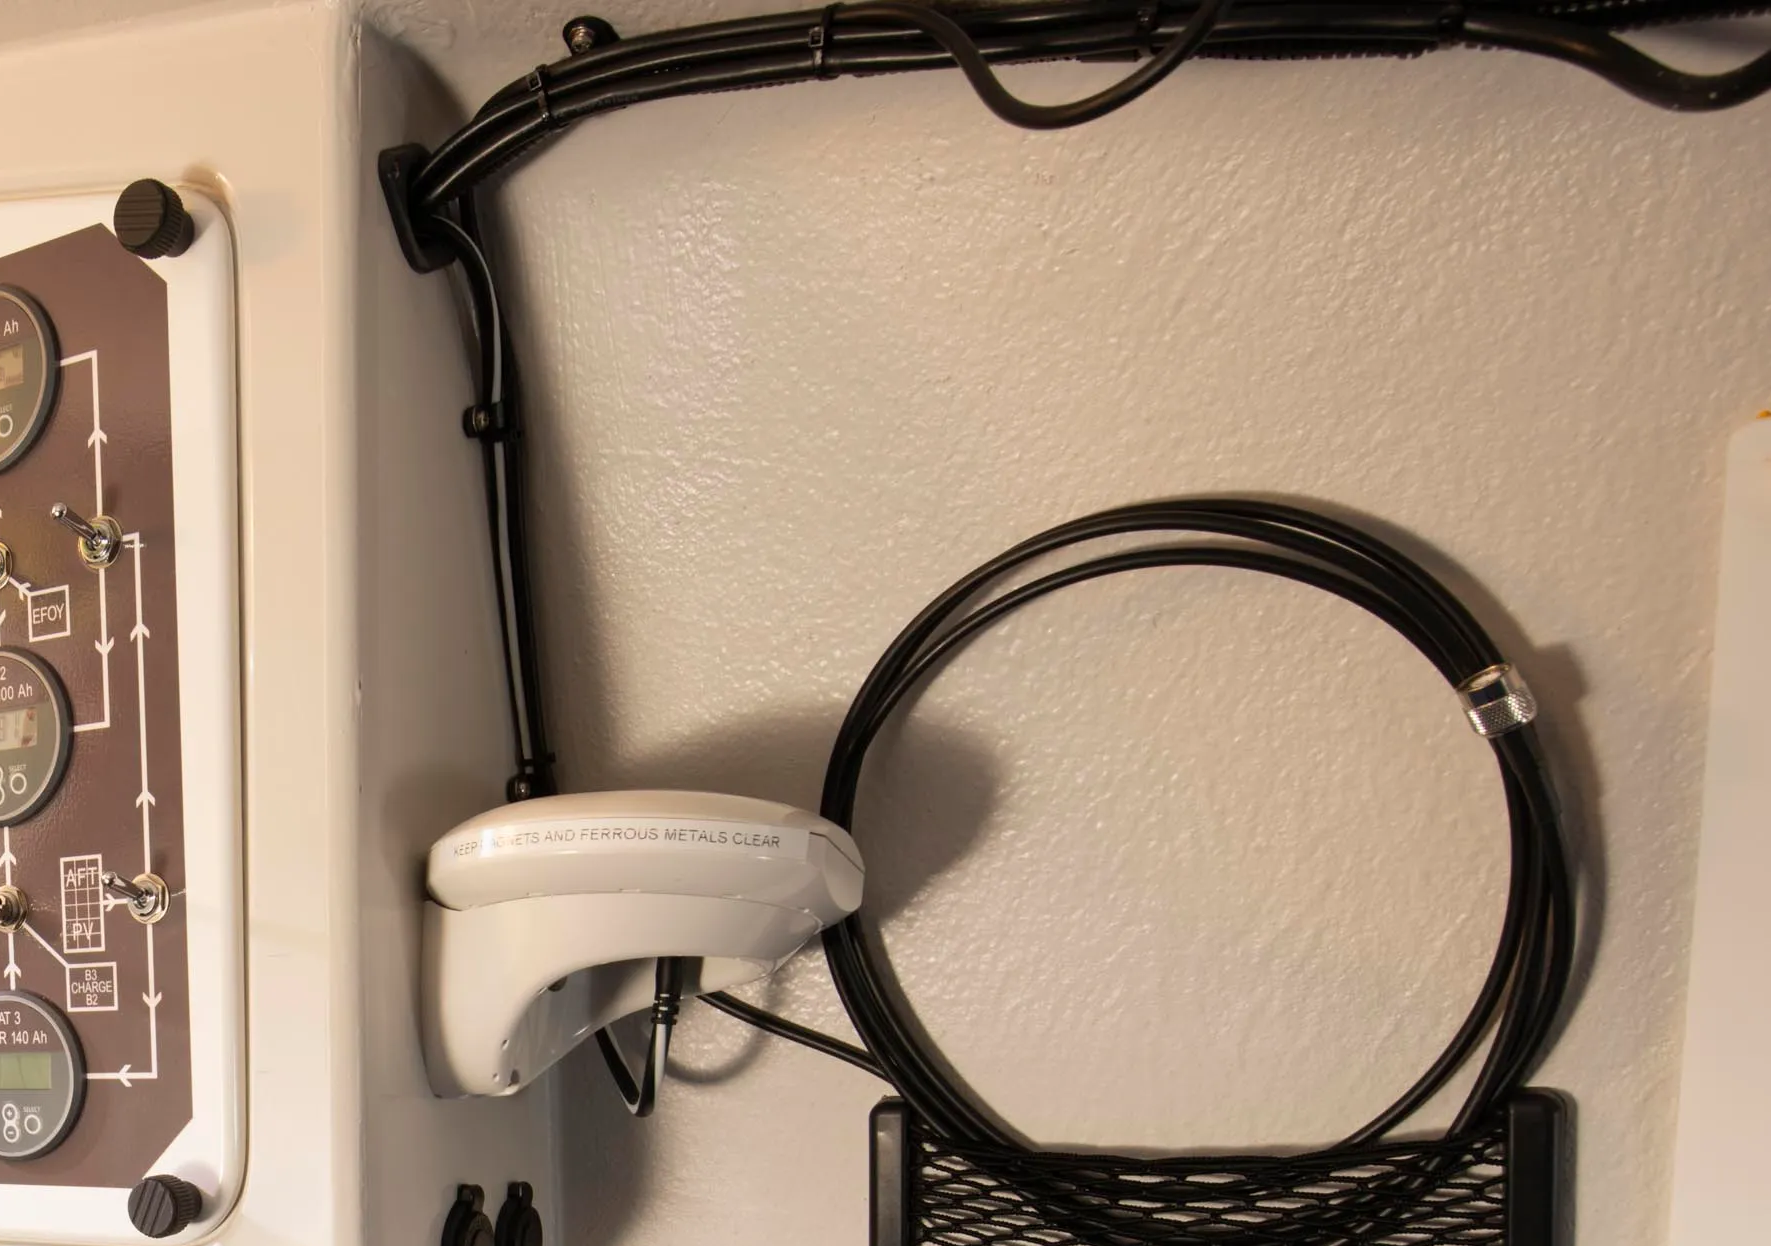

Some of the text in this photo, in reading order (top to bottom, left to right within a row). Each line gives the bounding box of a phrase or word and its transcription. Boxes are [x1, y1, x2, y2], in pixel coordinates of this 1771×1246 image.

[3, 319, 19, 337] Ah
[31, 602, 64, 625] EFOY
[0, 666, 7, 680] 2
[18, 683, 33, 699] Ah
[453, 841, 478, 857] KEEP
[544, 829, 576, 842] AND
[580, 827, 659, 841] FERROUS
[664, 828, 728, 844] METALS
[732, 832, 781, 848] CLEAR
[66, 867, 97, 888] AFT
[72, 921, 94, 941] PV
[84, 969, 97, 981] B3
[71, 981, 113, 994] CHARGE
[85, 994, 99, 1006] B2
[14, 1011, 21, 1025] 3
[11, 1031, 29, 1045] 140
[32, 1030, 48, 1044] Ah
